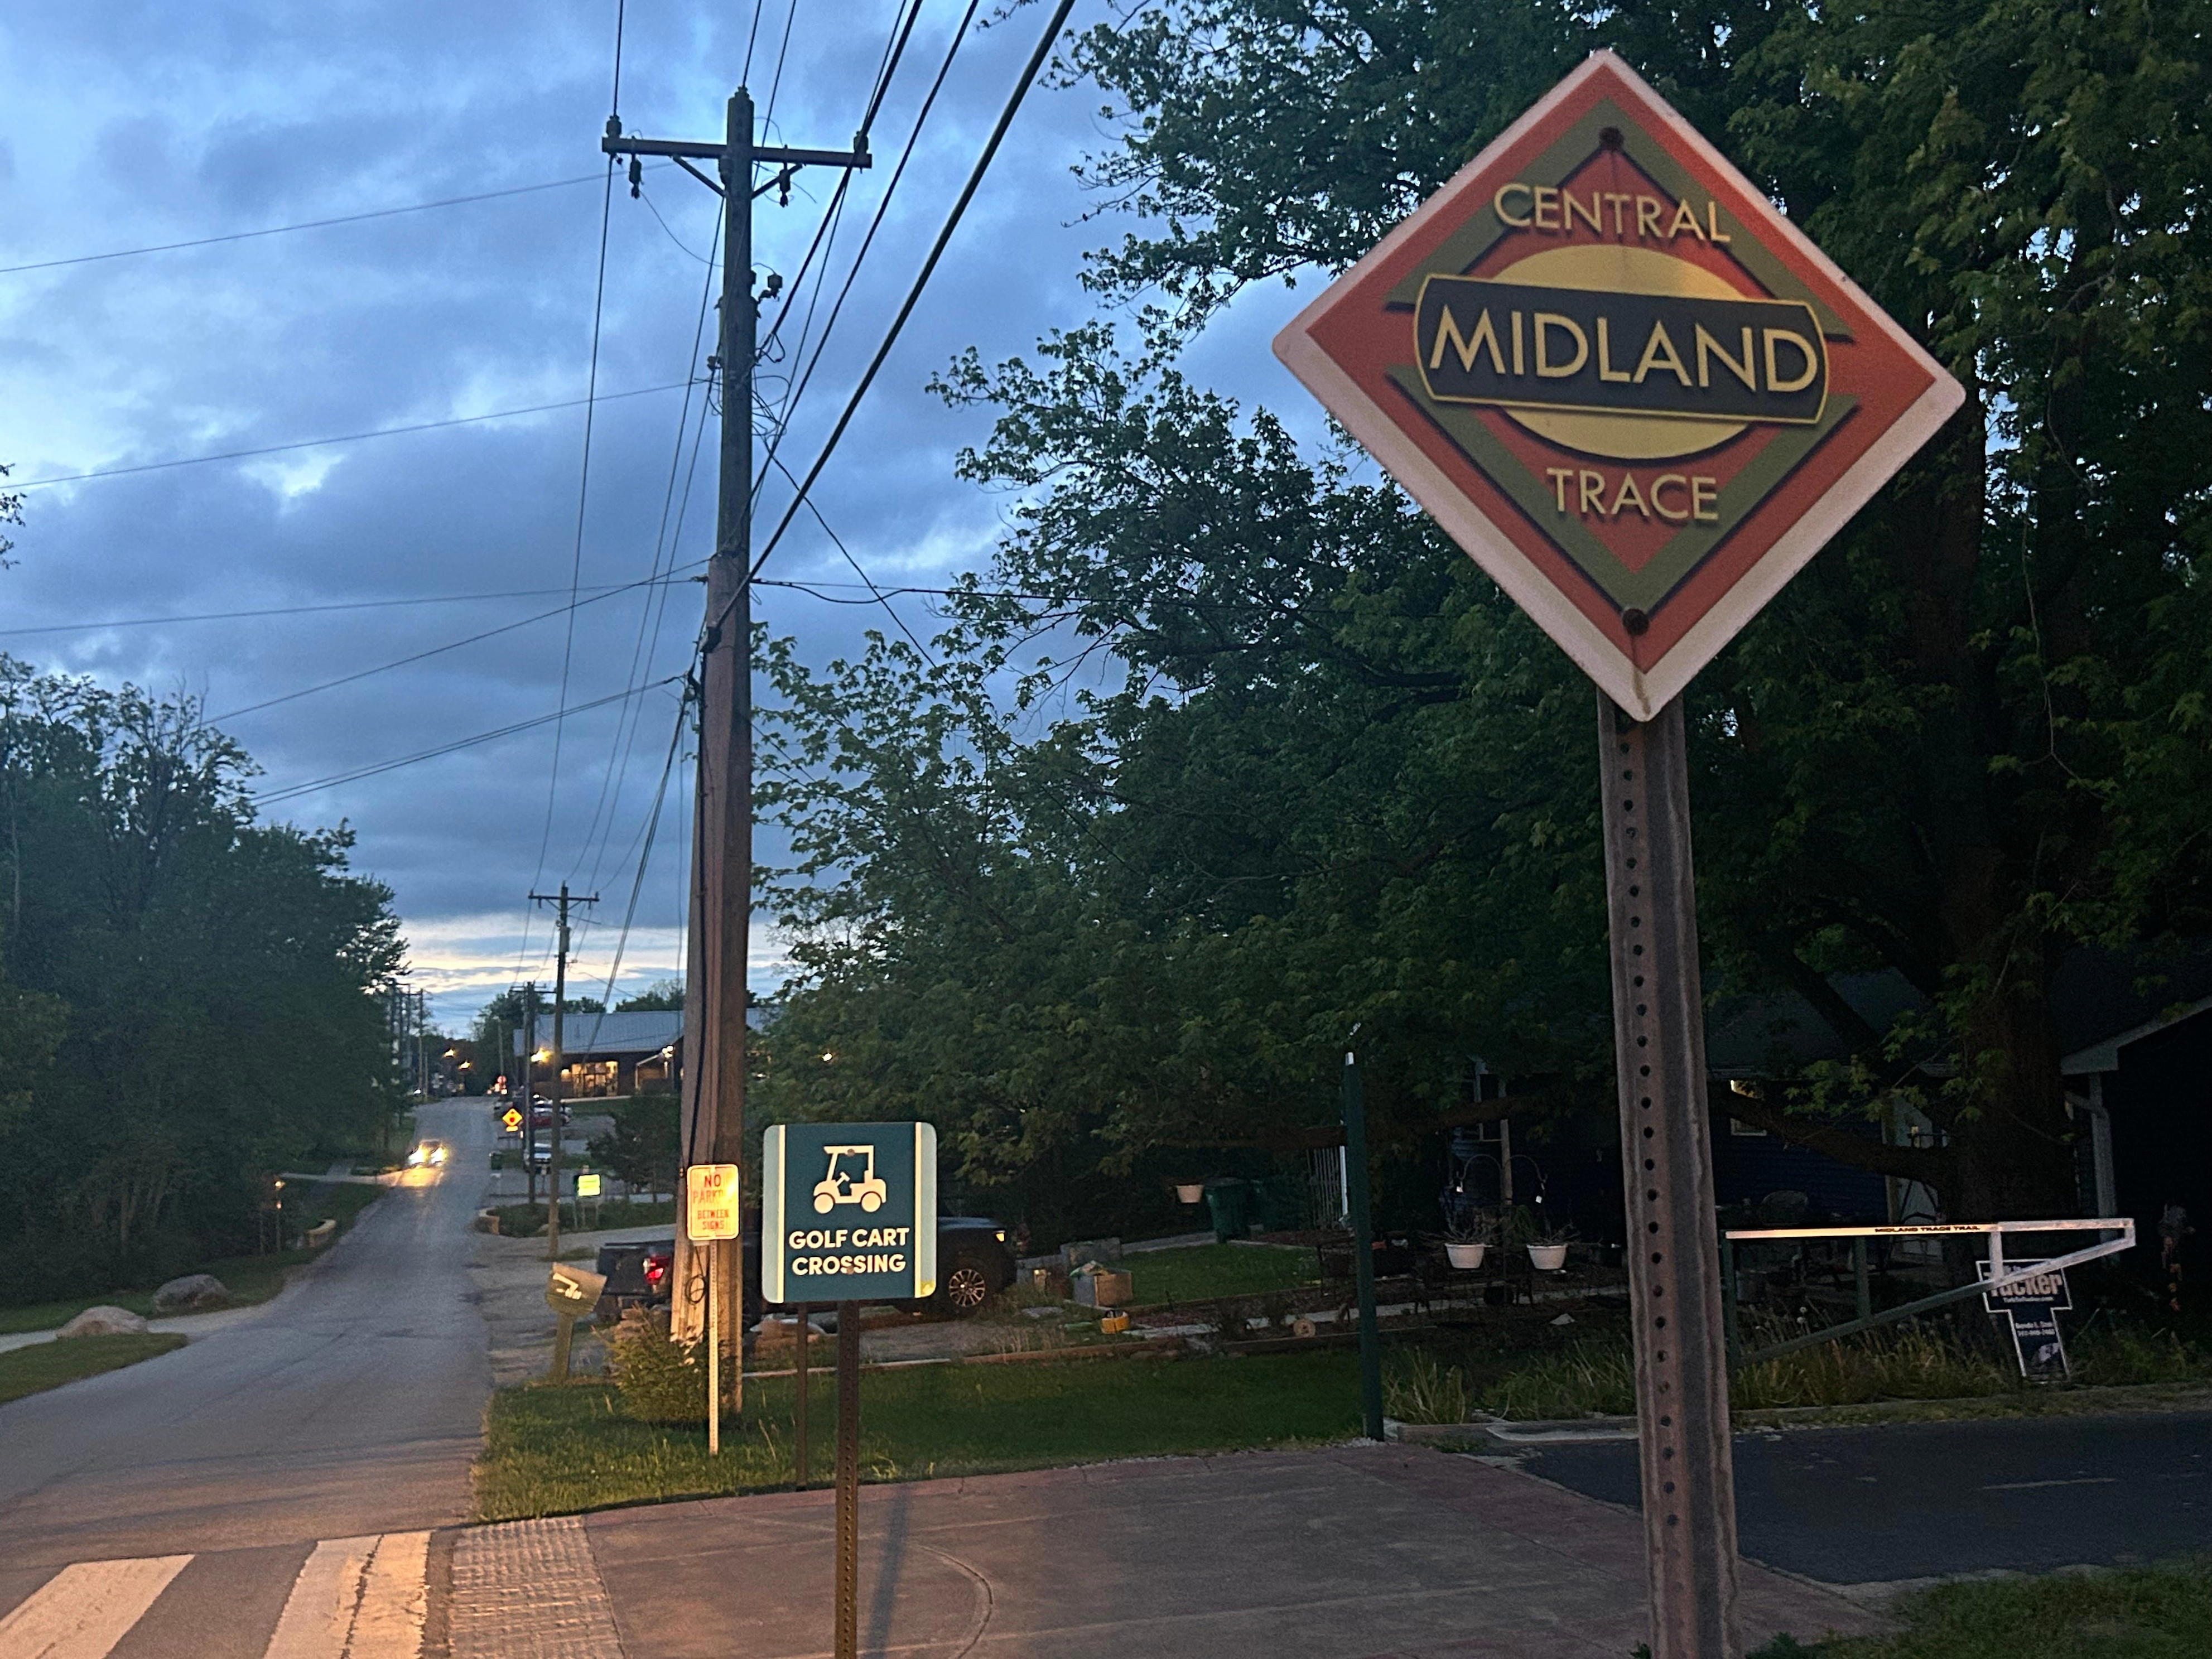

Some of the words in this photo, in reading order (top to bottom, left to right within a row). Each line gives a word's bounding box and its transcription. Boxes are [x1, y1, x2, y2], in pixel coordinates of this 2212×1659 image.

[1493, 183, 1731, 243] CENTRAL
[1429, 304, 1819, 393] MIDLAND
[1547, 468, 1719, 521] TRACE
[704, 1174, 721, 1187] NO
[788, 1229, 849, 1250] GOLF
[851, 1227, 910, 1248] CART
[792, 1253, 907, 1276] CROSSING
